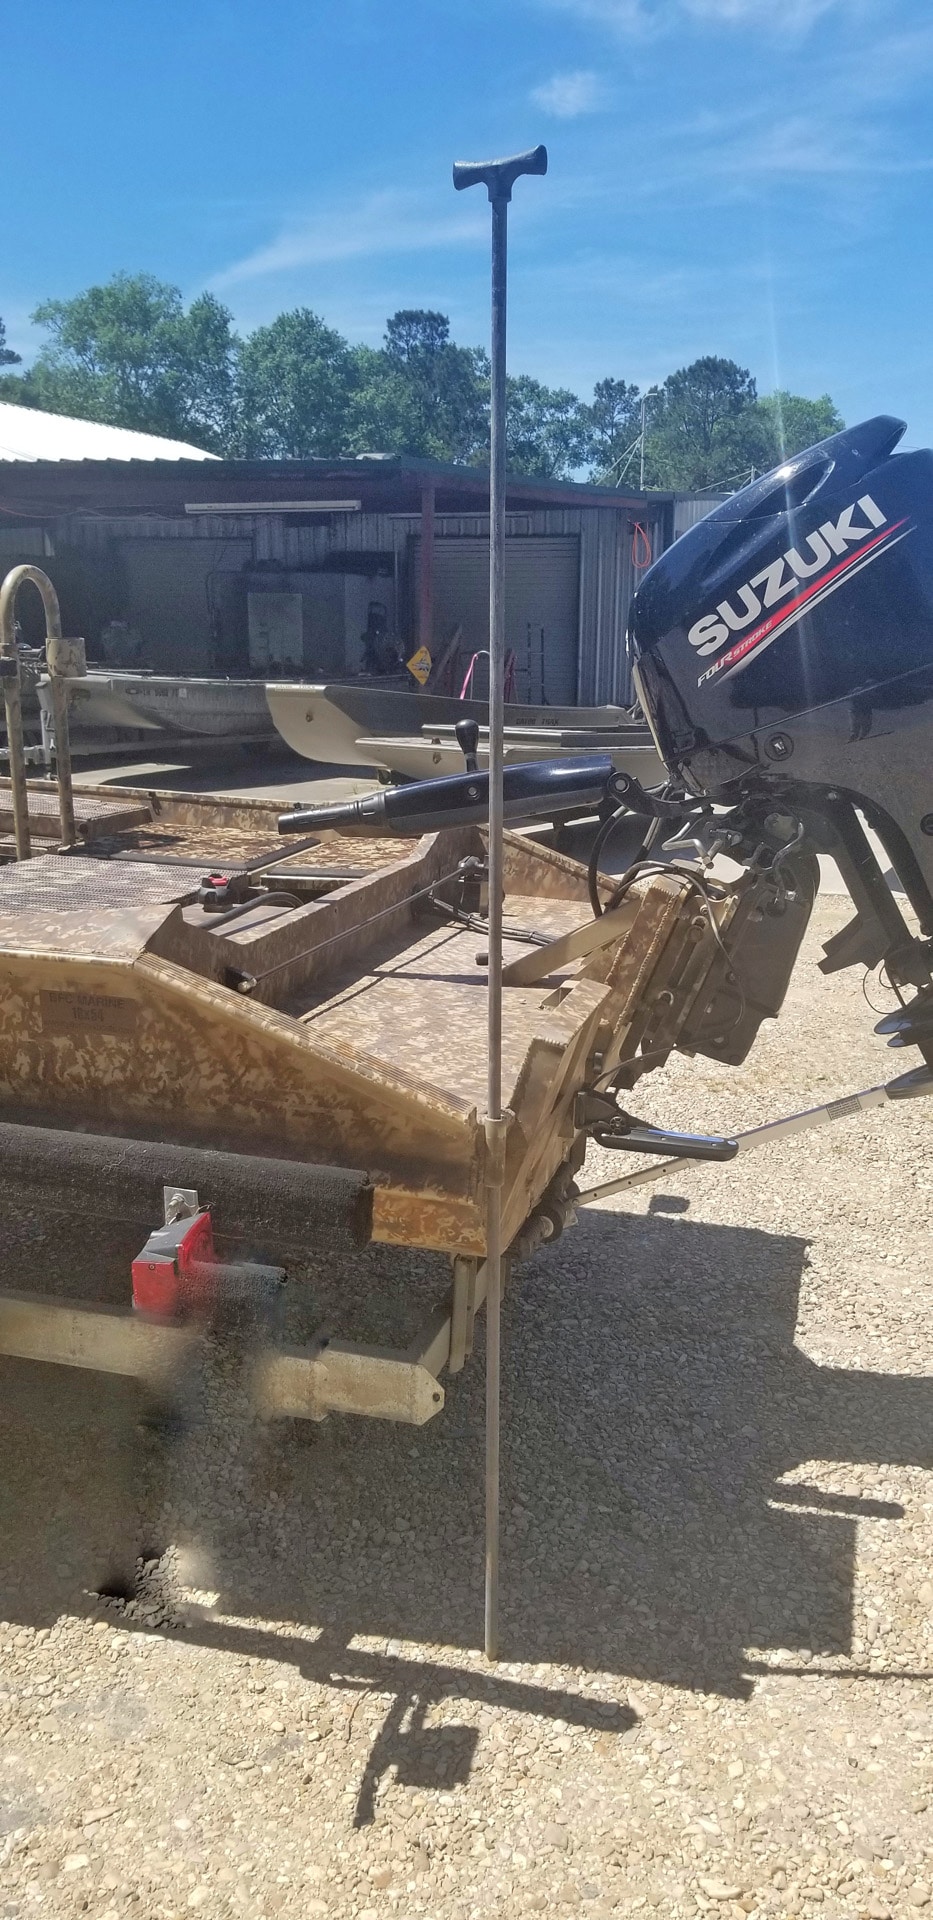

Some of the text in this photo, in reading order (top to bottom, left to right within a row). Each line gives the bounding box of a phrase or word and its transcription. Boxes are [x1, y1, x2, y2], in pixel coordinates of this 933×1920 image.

[688, 494, 887, 656] SUZUKI
[697, 620, 773, 688] FOUR STROKE
[48, 992, 126, 1010] BFC MARINE
